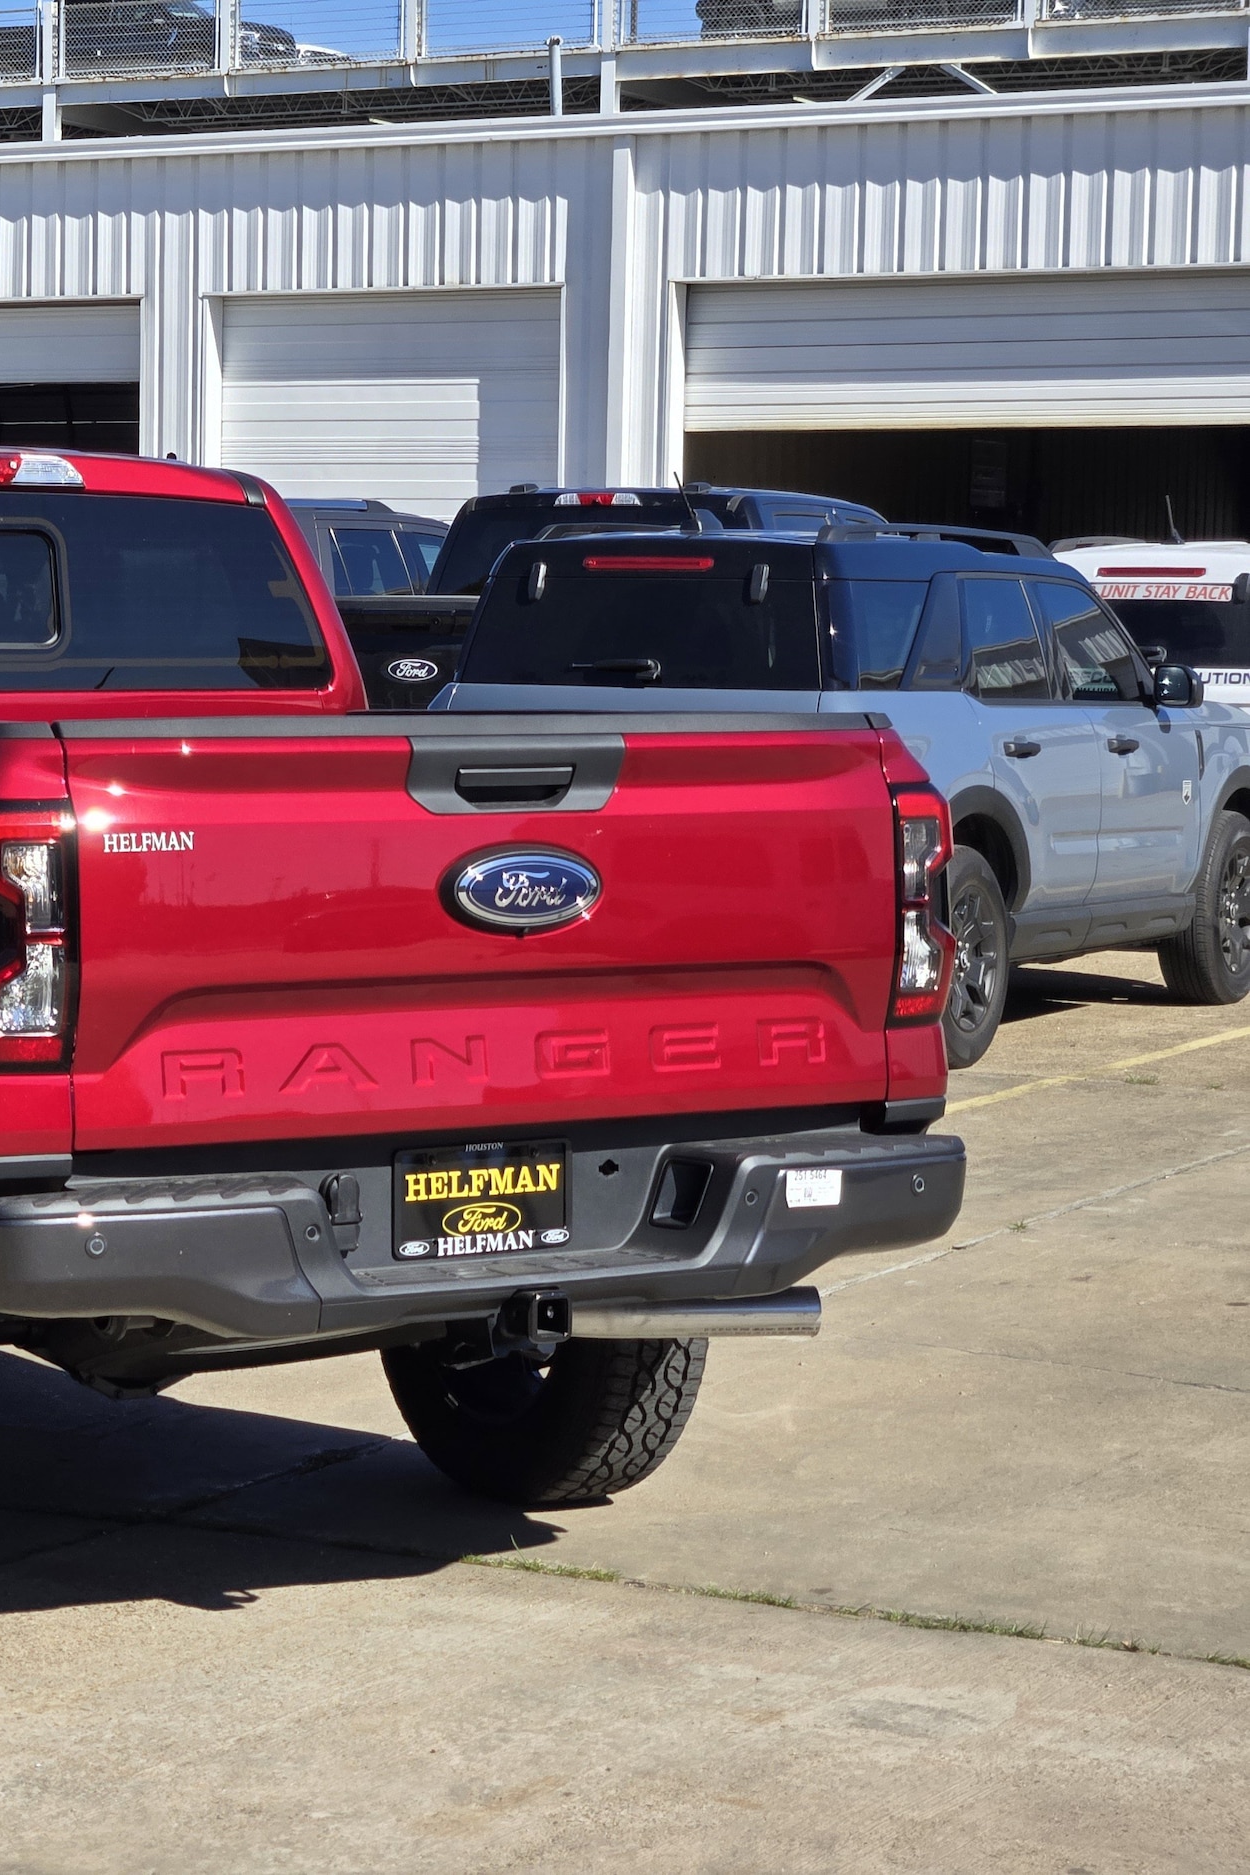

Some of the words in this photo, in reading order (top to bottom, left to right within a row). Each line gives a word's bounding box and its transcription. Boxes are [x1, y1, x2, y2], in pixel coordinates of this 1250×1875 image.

[1101, 585, 1140, 598] UNIT
[1142, 585, 1182, 598] STAY
[1185, 586, 1231, 600] BACK
[396, 661, 429, 677] Ford
[103, 831, 194, 853] HELFMAN
[495, 870, 567, 907] Ford
[161, 1016, 825, 1099] RANGER
[465, 1142, 504, 1152] HOUSTON
[405, 1164, 561, 1202] HELFMAN
[458, 1207, 508, 1233] Ford
[437, 1230, 535, 1256] HELFMAN
